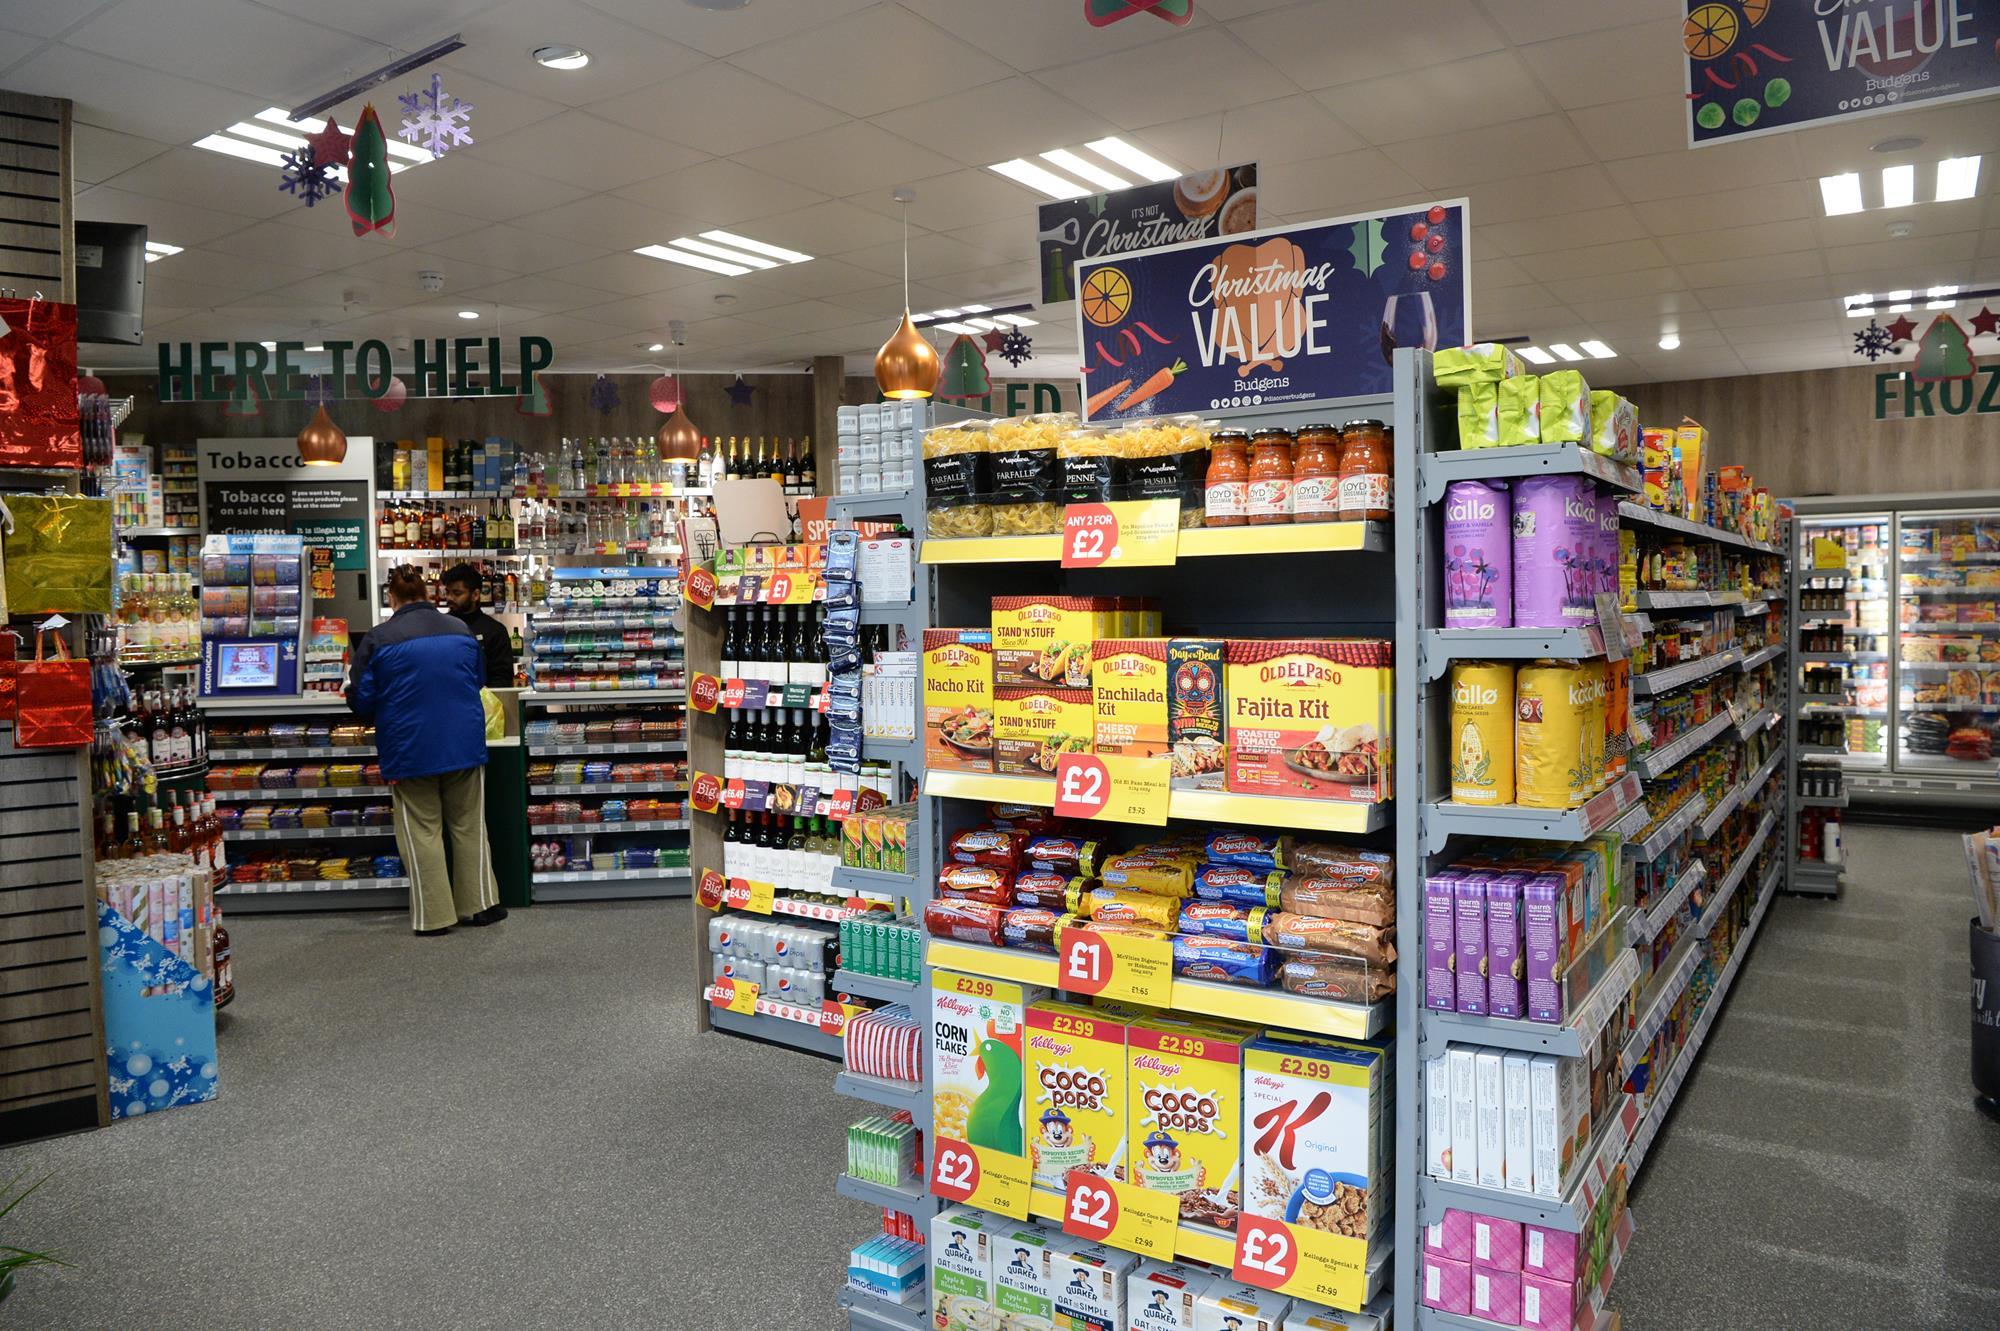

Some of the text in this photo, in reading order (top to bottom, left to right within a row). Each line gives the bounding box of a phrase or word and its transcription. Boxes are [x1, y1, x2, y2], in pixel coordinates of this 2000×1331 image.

[1816, 0, 1977, 72] VALUE
[1866, 70, 1930, 92] Budgens
[1145, 204, 1159, 216] NOT
[1083, 214, 1216, 259] Christmas
[1189, 262, 1335, 307] Christmas
[1191, 293, 1331, 368] VALUE
[158, 336, 554, 402] HERE TO HELP
[1234, 376, 1289, 392] Budgens
[998, 456, 1030, 465] Napolina
[1065, 462, 1097, 472] Napolina
[931, 472, 966, 485] FARFALLE
[996, 471, 1035, 480] FARFALLE
[1066, 474, 1096, 483] PENNE
[1143, 476, 1177, 486] FUSILLI
[220, 490, 286, 503] Tobacco
[1209, 490, 1231, 499] LOYD
[237, 507, 258, 515] sale
[264, 507, 285, 515] here
[1067, 515, 1112, 526] ANY 2 FOR
[231, 537, 300, 545] SCRATCHCARDS
[326, 535, 358, 543] products
[1071, 529, 1104, 559] £2
[691, 577, 712, 595] Big
[772, 579, 788, 598] £1
[997, 627, 1020, 638] STAND
[1031, 627, 1055, 638] STUFF
[1170, 648, 1220, 662] Day Dead
[204, 641, 213, 694] SCRATCHCARDS
[696, 683, 716, 699] Big
[927, 679, 984, 693] Nacho Kit
[726, 689, 744, 698] £5.99
[1097, 688, 1164, 703] Enchilada
[1098, 703, 1116, 716] Kit
[1237, 697, 1330, 720] Fajita Kit
[999, 717, 1023, 728] STAND
[1032, 719, 1056, 729] STUFF
[1097, 723, 1137, 735] CHEESY
[1097, 735, 1133, 746] BAKED
[1237, 730, 1280, 738] ROASTED
[1237, 737, 1277, 746] TOMATO
[1246, 746, 1283, 754] PEPPER
[696, 781, 717, 798] Big
[1061, 765, 1103, 805] £2
[726, 789, 744, 799] £6.49
[831, 800, 850, 811] £6.49
[1216, 841, 1257, 852] Digestives
[1330, 865, 1373, 876] Digestives
[1023, 879, 1060, 887] Digestives
[1207, 873, 1248, 884] Digestives
[703, 881, 721, 898] Big
[730, 888, 751, 901] £4.99
[1011, 912, 1049, 923] Digestives
[1097, 911, 1134, 920] Digestives
[1190, 907, 1231, 916] Digestives
[1290, 921, 1335, 931] Digestives
[1068, 941, 1101, 981] £1
[1141, 957, 1168, 966] Digestives
[956, 978, 993, 996] £2.99
[714, 988, 735, 1001] £3.99
[937, 996, 974, 1016] Kellogg's
[821, 1011, 844, 1026] £3.99
[936, 1021, 968, 1043] CORN
[1053, 1016, 1094, 1037] £2.99
[936, 1038, 967, 1056] FLAKES
[1030, 1036, 1072, 1056] Kellogg's
[1158, 1036, 1204, 1056] £2.99
[1134, 1055, 1181, 1076] Kellogg's
[1279, 1058, 1330, 1079] £2.99
[1254, 1076, 1286, 1090] Kellogg's
[1254, 1092, 1282, 1103] SPECIAL
[1253, 1091, 1332, 1170] K
[1304, 1140, 1337, 1152] Original
[937, 1149, 973, 1191] £2
[1070, 1185, 1111, 1229] £2
[1135, 1237, 1154, 1248] £2.99
[945, 1248, 973, 1264] QUAKER
[1241, 1228, 1288, 1277] £2
[1303, 1252, 1330, 1263] Kelloggs
[1330, 1258, 1353, 1269] Special
[937, 1258, 982, 1278] OAT SIMPLE
[1007, 1266, 1038, 1281] QUAKER
[942, 1273, 958, 1284] Apple
[1000, 1275, 1048, 1296] OAT SIMPLE
[850, 1276, 889, 1298] Imodium
[1066, 1286, 1098, 1302] QUAKER
[1316, 1284, 1338, 1297] £2.99
[1005, 1292, 1022, 1302] Apple
[1057, 1295, 1108, 1317] OAT SIMPLE
[1062, 1308, 1105, 1326] VARIETY PACK
[1134, 1318, 1151, 1329] OAT
[1143, 1308, 1177, 1327] QUAKER
